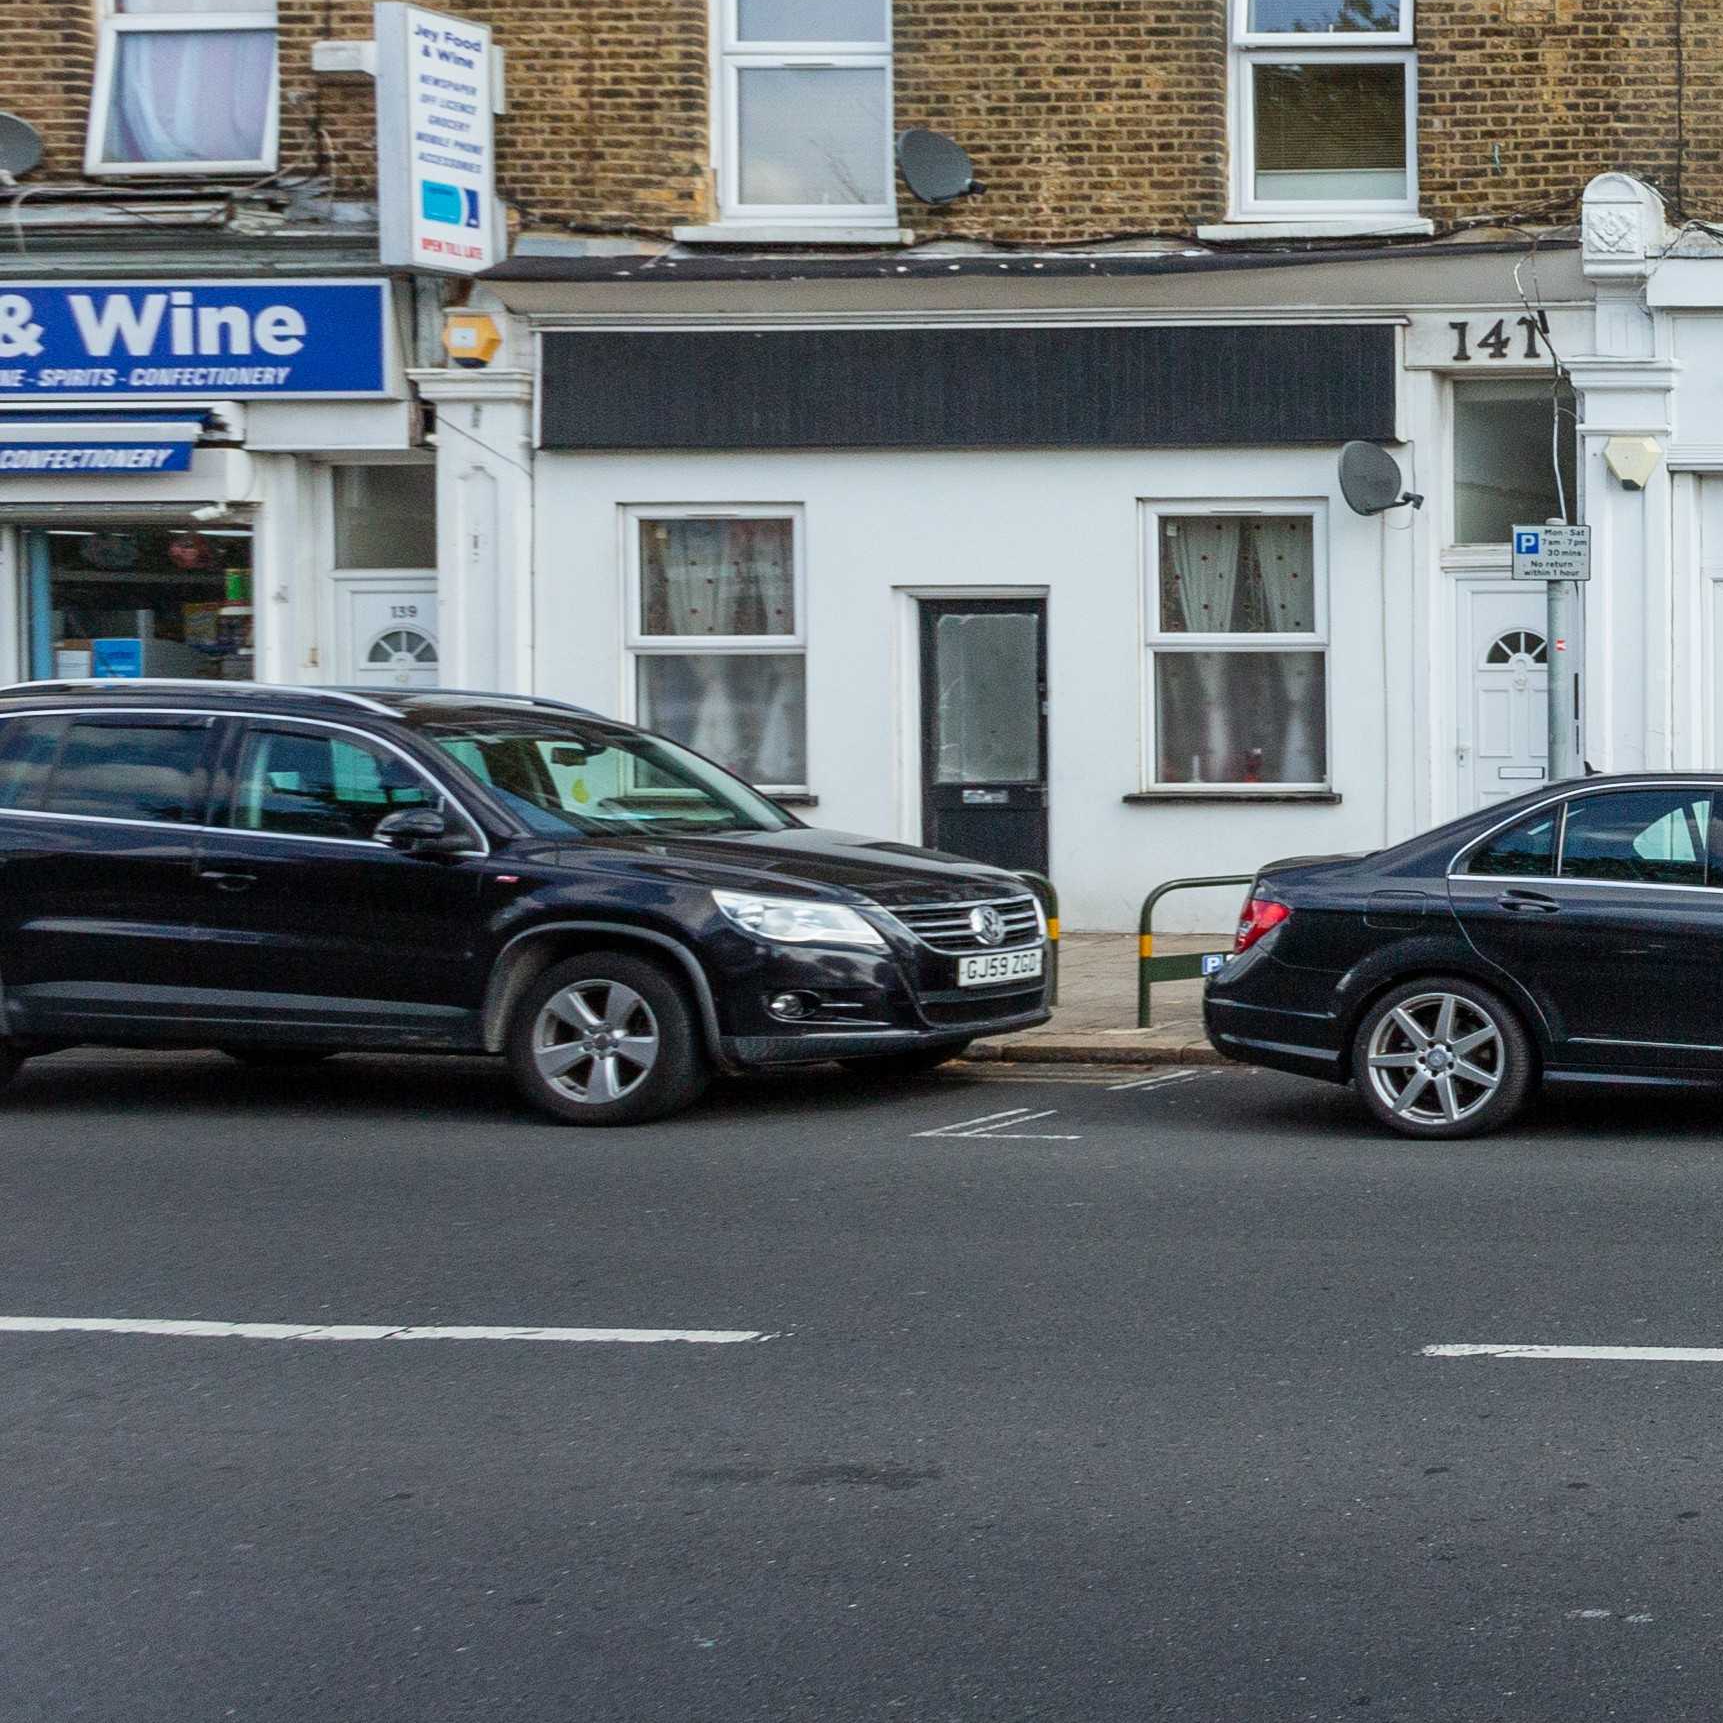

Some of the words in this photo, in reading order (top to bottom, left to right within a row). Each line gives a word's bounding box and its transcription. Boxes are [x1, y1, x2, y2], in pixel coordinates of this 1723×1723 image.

[444, 31, 482, 52] Food
[436, 48, 474, 69] Wine
[420, 74, 478, 96] NEWSPAPER
[0, 294, 44, 357] &
[68, 291, 307, 357] Wine
[1448, 316, 1541, 361] 141
[37, 368, 118, 387] SPIRITS
[129, 366, 291, 386] CONFECTIONERY
[0, 448, 174, 469] CONFECTIONERY
[1569, 528, 1585, 536] Sat
[390, 604, 418, 618] 139
[967, 957, 1008, 979] GJ59
